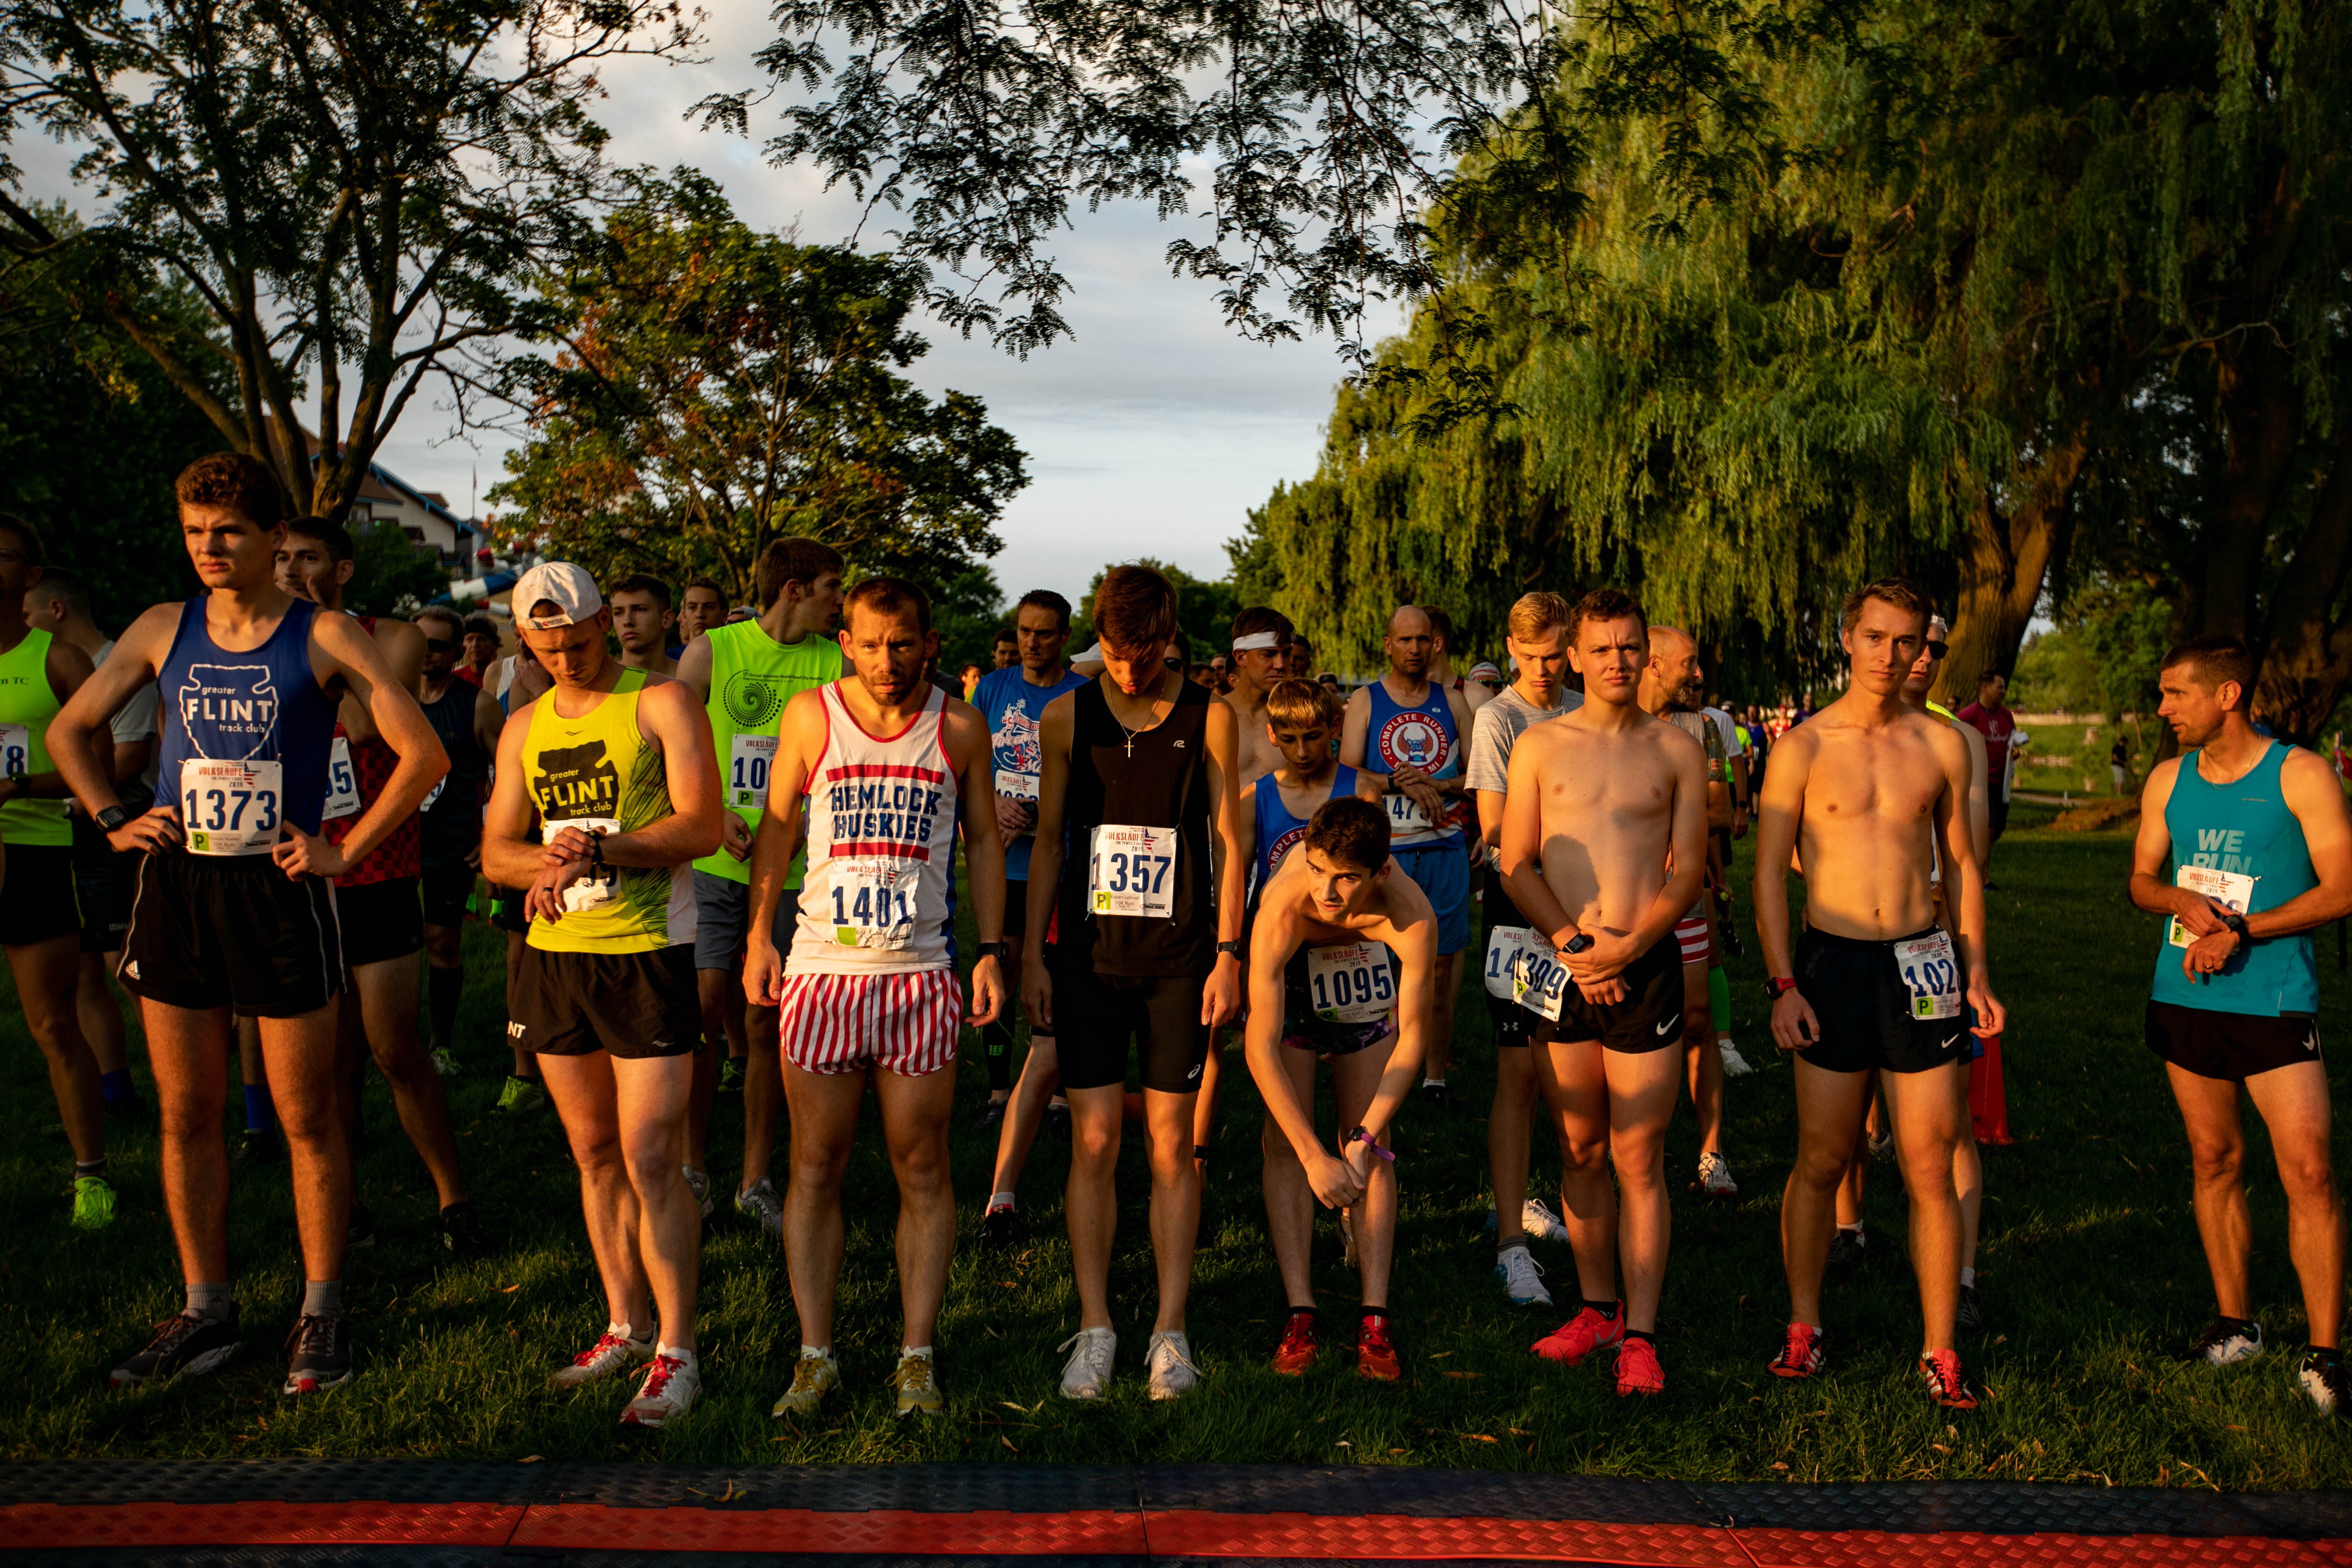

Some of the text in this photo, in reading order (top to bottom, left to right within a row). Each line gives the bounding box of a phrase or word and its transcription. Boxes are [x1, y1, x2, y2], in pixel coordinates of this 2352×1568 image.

[12, 677, 29, 685] TC
[202, 687, 236, 695] greater
[187, 698, 273, 721] FLINT
[219, 724, 265, 733] track club
[1382, 714, 1447, 756] COMPLETE RUNNER
[0, 745, 24, 777] 8
[199, 766, 243, 777] VOLKSLÄUFE
[549, 769, 580, 782] greater
[733, 757, 773, 790] 10
[539, 775, 614, 810] FLINT
[741, 792, 749, 804] P
[830, 784, 942, 816] HEMLOCK
[186, 789, 277, 831] 1373
[570, 801, 612, 816] track club
[833, 813, 932, 842] HUSKIES
[1105, 831, 1144, 841] VOLKSLÄUFE
[195, 834, 204, 848] P
[1270, 829, 1307, 870] OMPLET
[2198, 828, 2245, 853] WE
[1091, 853, 1171, 894] 1357
[832, 886, 913, 927] 1401
[1097, 894, 1106, 908] P
[1504, 931, 1523, 940] VOLKSL
[2175, 927, 2181, 940] P
[1322, 948, 1359, 961] VOLKSLÄUFE
[1487, 947, 1516, 980] 14
[1516, 946, 1567, 1000] 1309
[1314, 964, 1392, 1009] 1095
[1919, 1000, 1928, 1014] P
[507, 1021, 526, 1038] NT
